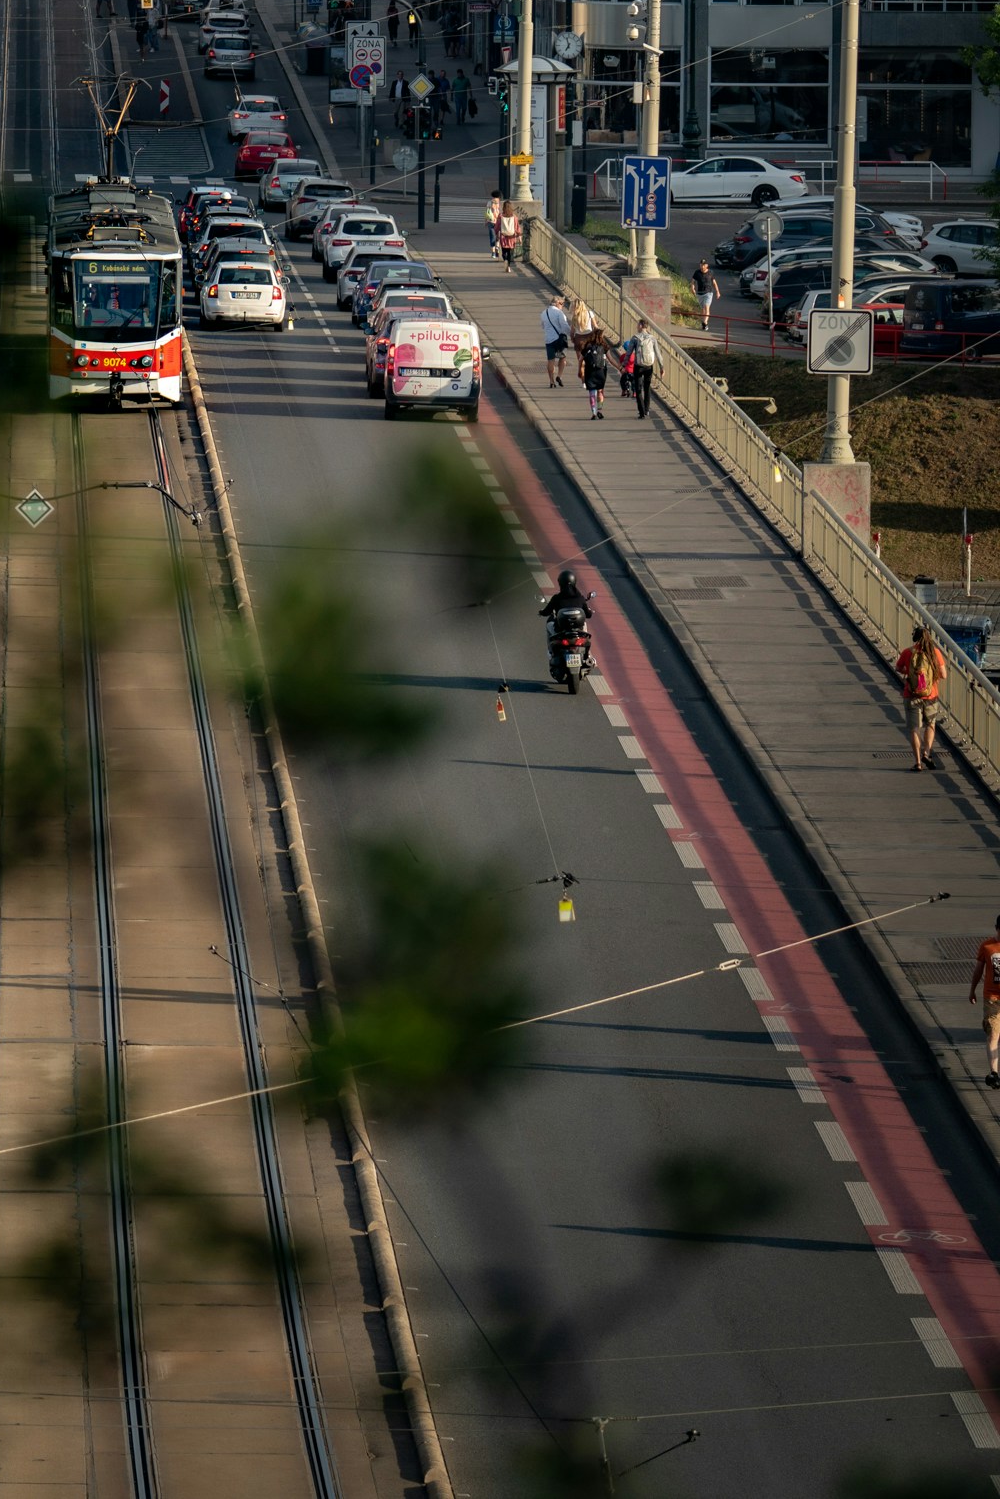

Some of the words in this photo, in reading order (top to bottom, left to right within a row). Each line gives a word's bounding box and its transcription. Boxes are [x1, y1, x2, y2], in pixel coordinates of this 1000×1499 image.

[356, 38, 381, 48] ZÓNA
[89, 262, 98, 273] 6
[102, 264, 130, 272] Kubánské
[103, 357, 127, 367] 9074
